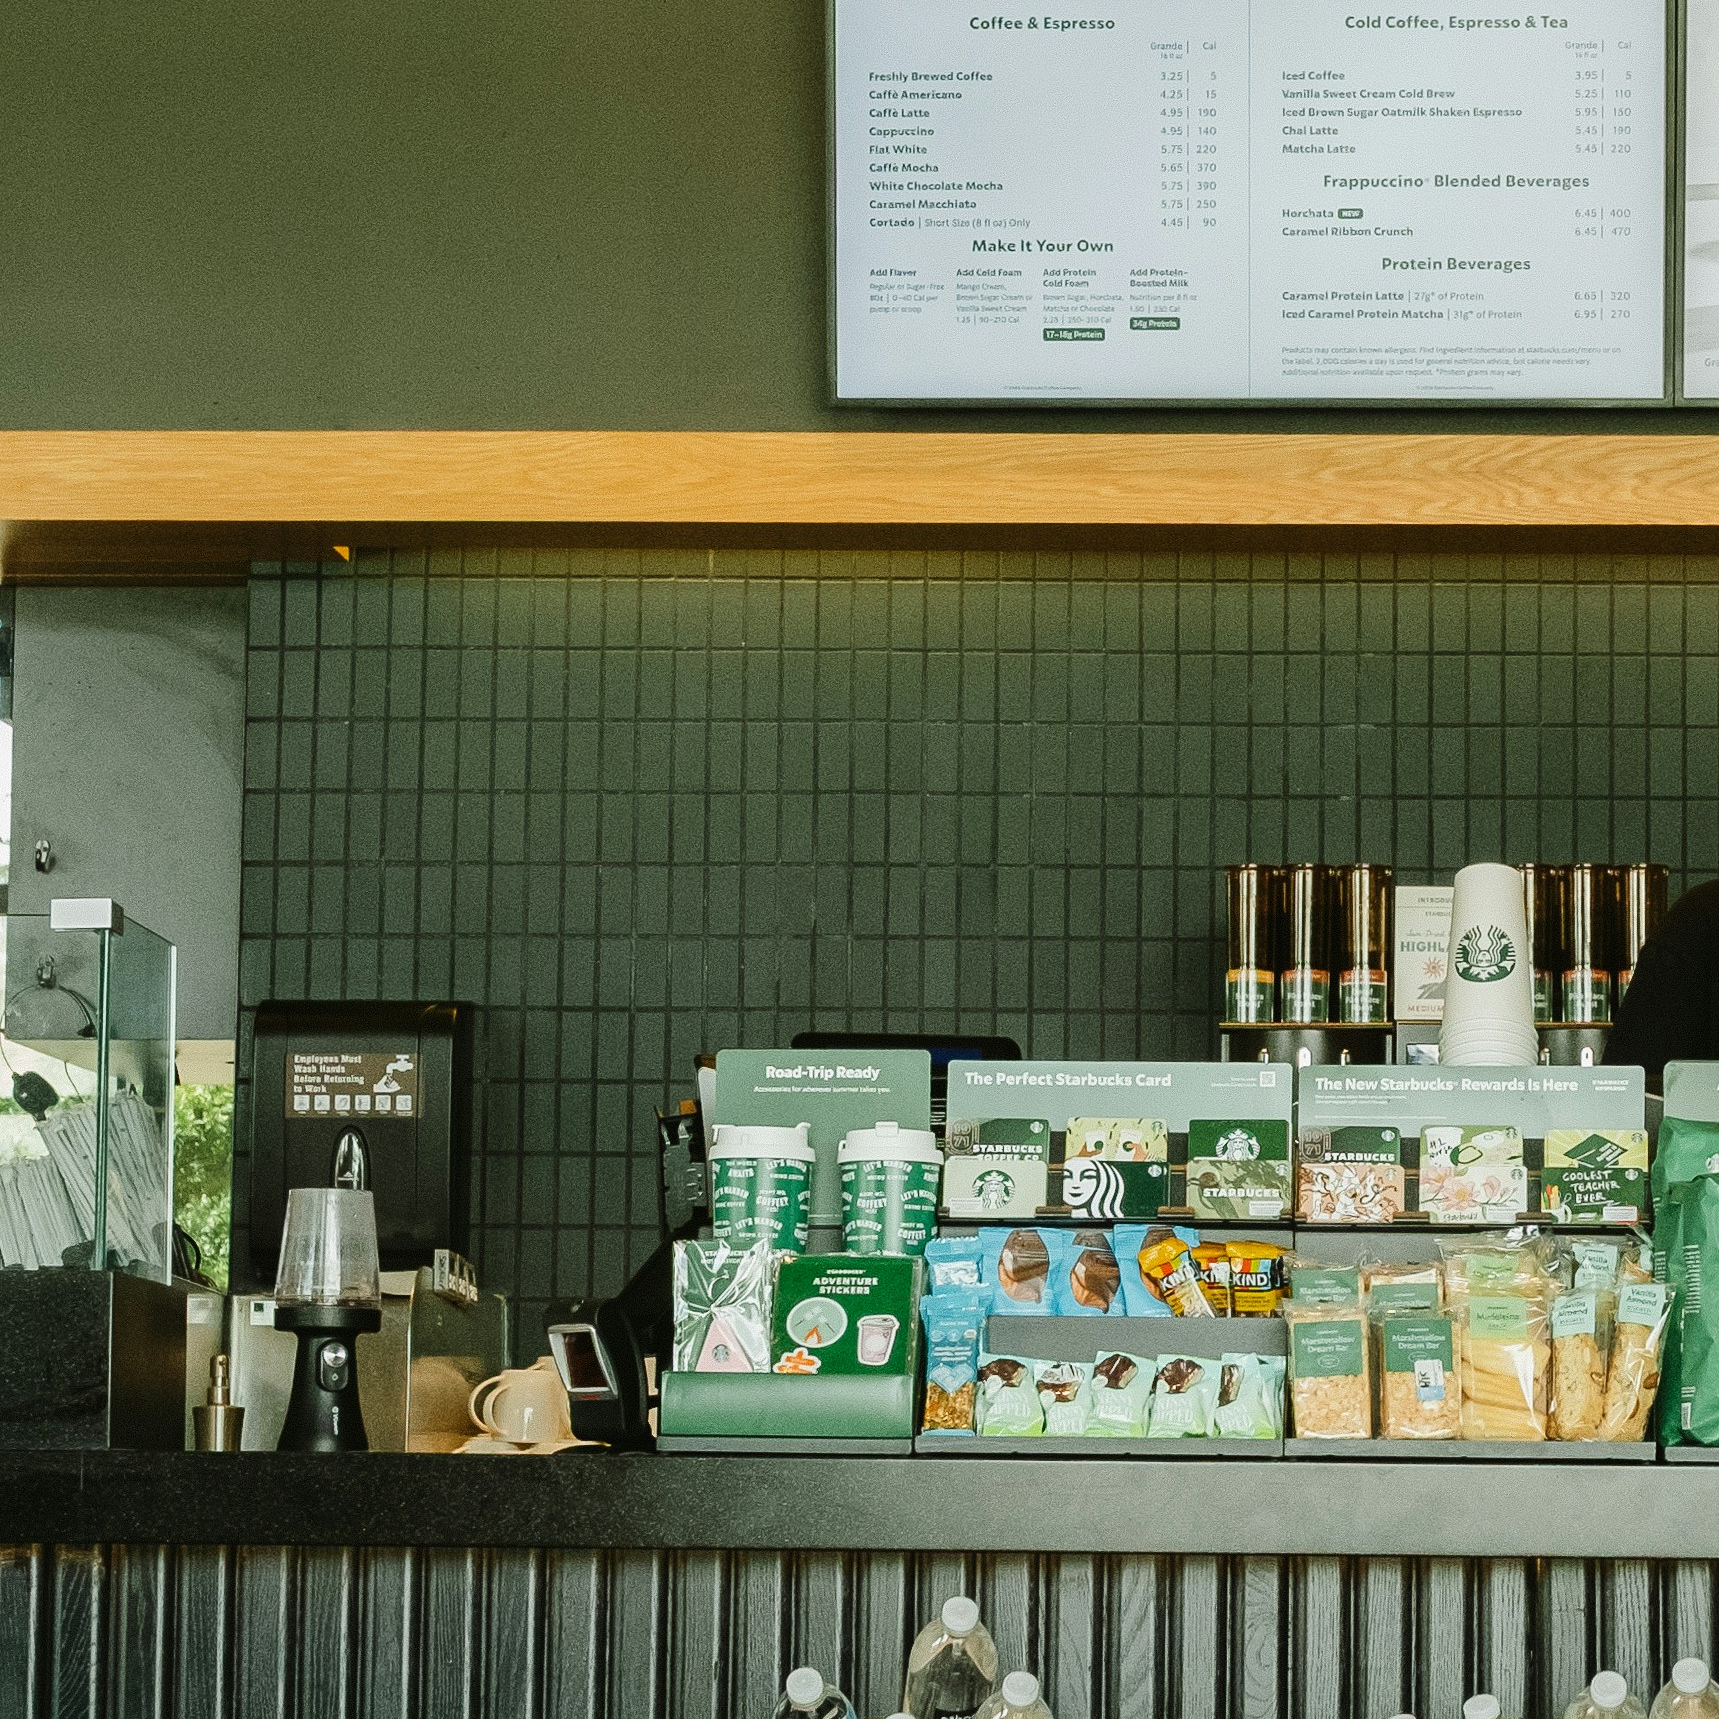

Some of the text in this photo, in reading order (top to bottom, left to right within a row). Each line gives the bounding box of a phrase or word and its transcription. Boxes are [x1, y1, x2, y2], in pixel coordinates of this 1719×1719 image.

[970, 17, 1115, 31] Coffee & Espresso
[1345, 16, 1567, 31] Cold Coffee, Espresso & Tea
[869, 72, 992, 83] Freshly Brewed Coffee
[1282, 71, 1345, 80] Iced Coffee
[869, 90, 962, 99] Caffè Americano
[1282, 89, 1455, 98] Vanilla Sweet Cream Cold Brew
[869, 109, 929, 117] Caffè Latte
[870, 145, 927, 154] Flat White
[869, 181, 1003, 190] White Chocolate Mocha
[1435, 175, 1500, 187] Blended
[1506, 175, 1589, 190] Beverages
[869, 200, 976, 209] Caramel Macchiato
[1282, 227, 1413, 236] Caramel Ribbon Crunch
[972, 239, 1113, 252] Make It Your Own
[1382, 257, 1530, 273] Protein Beverages
[294, 1055, 362, 1064] Employees Must
[294, 1065, 345, 1073] Wash Hands
[766, 1066, 881, 1081] Road-Trip Ready
[294, 1075, 364, 1085] Before Returning
[965, 1072, 1171, 1087] The Perfect Starbucks Card
[294, 1085, 327, 1093] to Work
[1315, 1078, 1342, 1091] The
[1345, 1078, 1378, 1091] New
[1462, 1078, 1525, 1092] Rewards
[1528, 1078, 1540, 1092] Is
[1543, 1078, 1579, 1092] Here
[972, 1145, 1042, 1153] STARBUCKS
[1324, 1153, 1395, 1161] STARBUCKS
[1562, 1170, 1612, 1182] COOLEST
[1569, 1181, 1620, 1192] TEACHER
[1202, 1188, 1279, 1198] STARBUCKS
[813, 1277, 878, 1285] ADVENTURE
[1233, 1273, 1268, 1286] KIND
[819, 1286, 870, 1294] STICKERS
